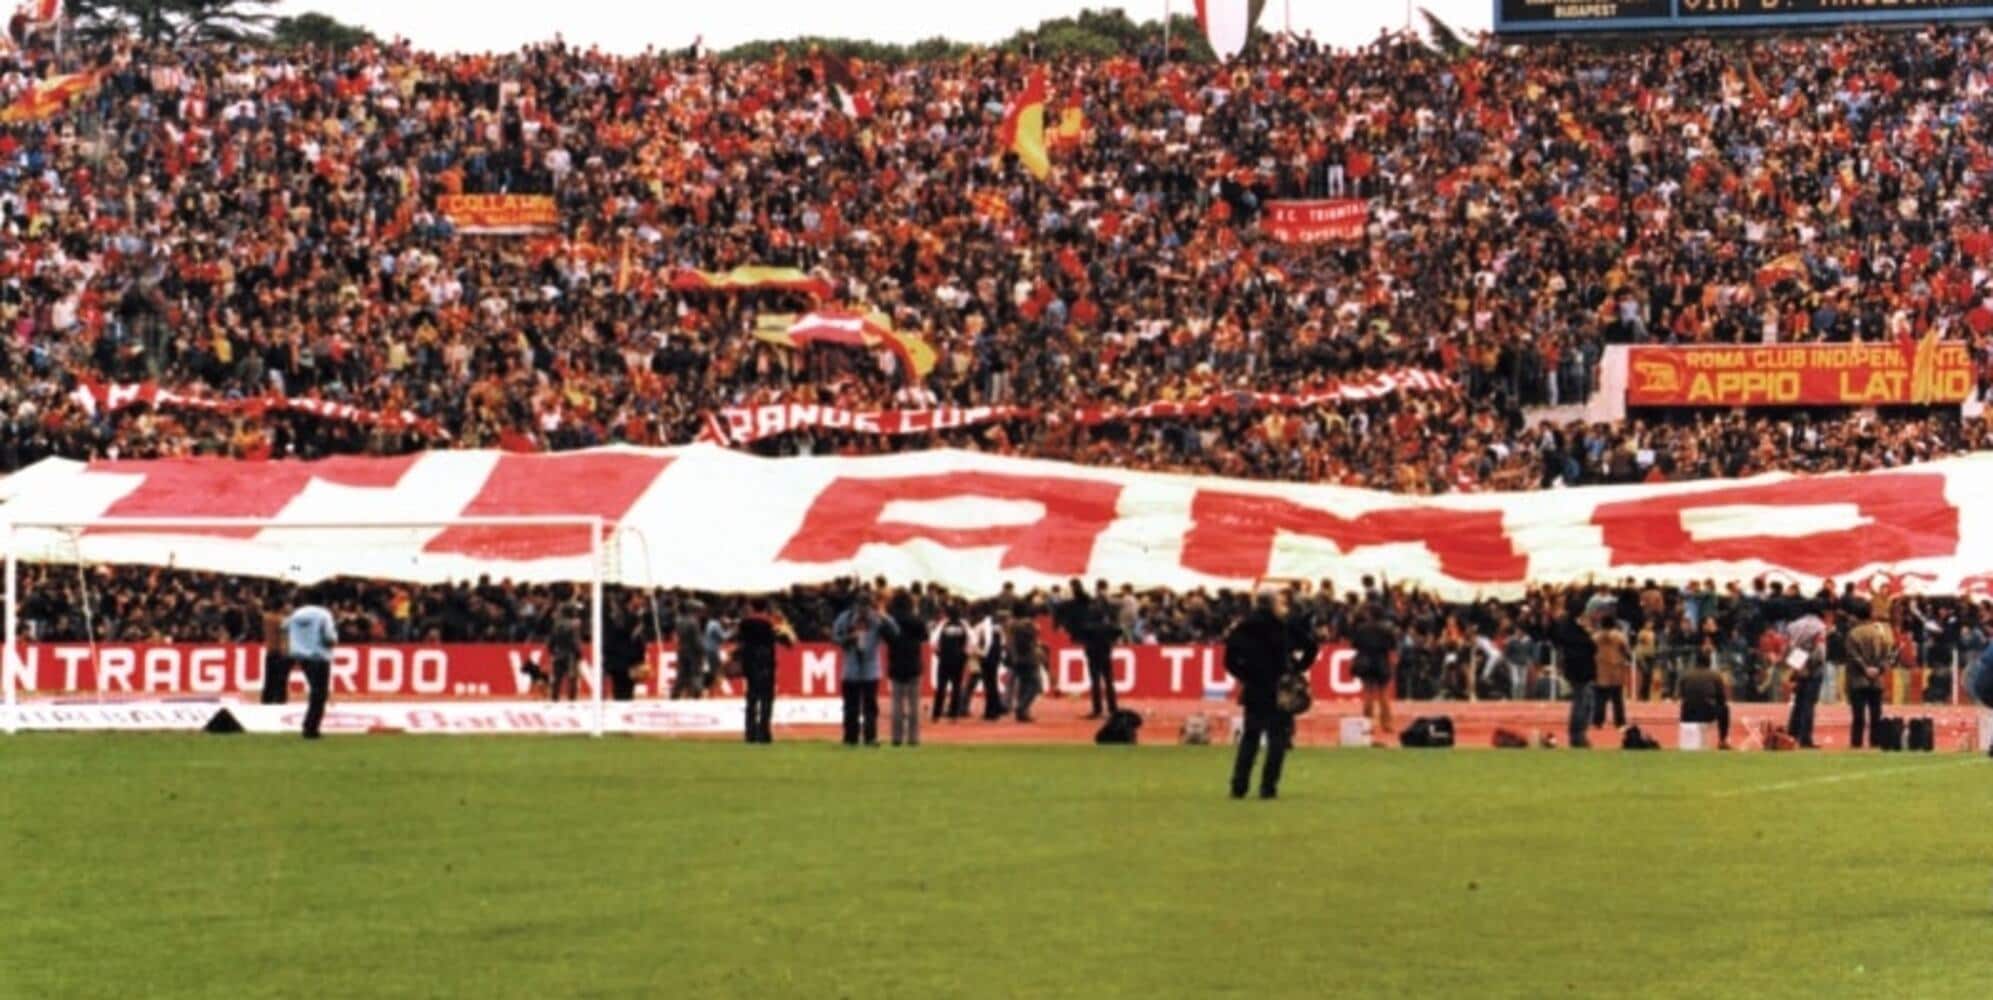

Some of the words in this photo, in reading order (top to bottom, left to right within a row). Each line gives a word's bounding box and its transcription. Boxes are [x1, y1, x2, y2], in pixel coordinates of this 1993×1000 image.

[1686, 351, 1746, 368] ROMA
[1753, 349, 1805, 368] CLUB
[1687, 371, 1800, 402] APPIO
[775, 470, 1960, 583] AMO
[404, 709, 582, 729] Barilla
